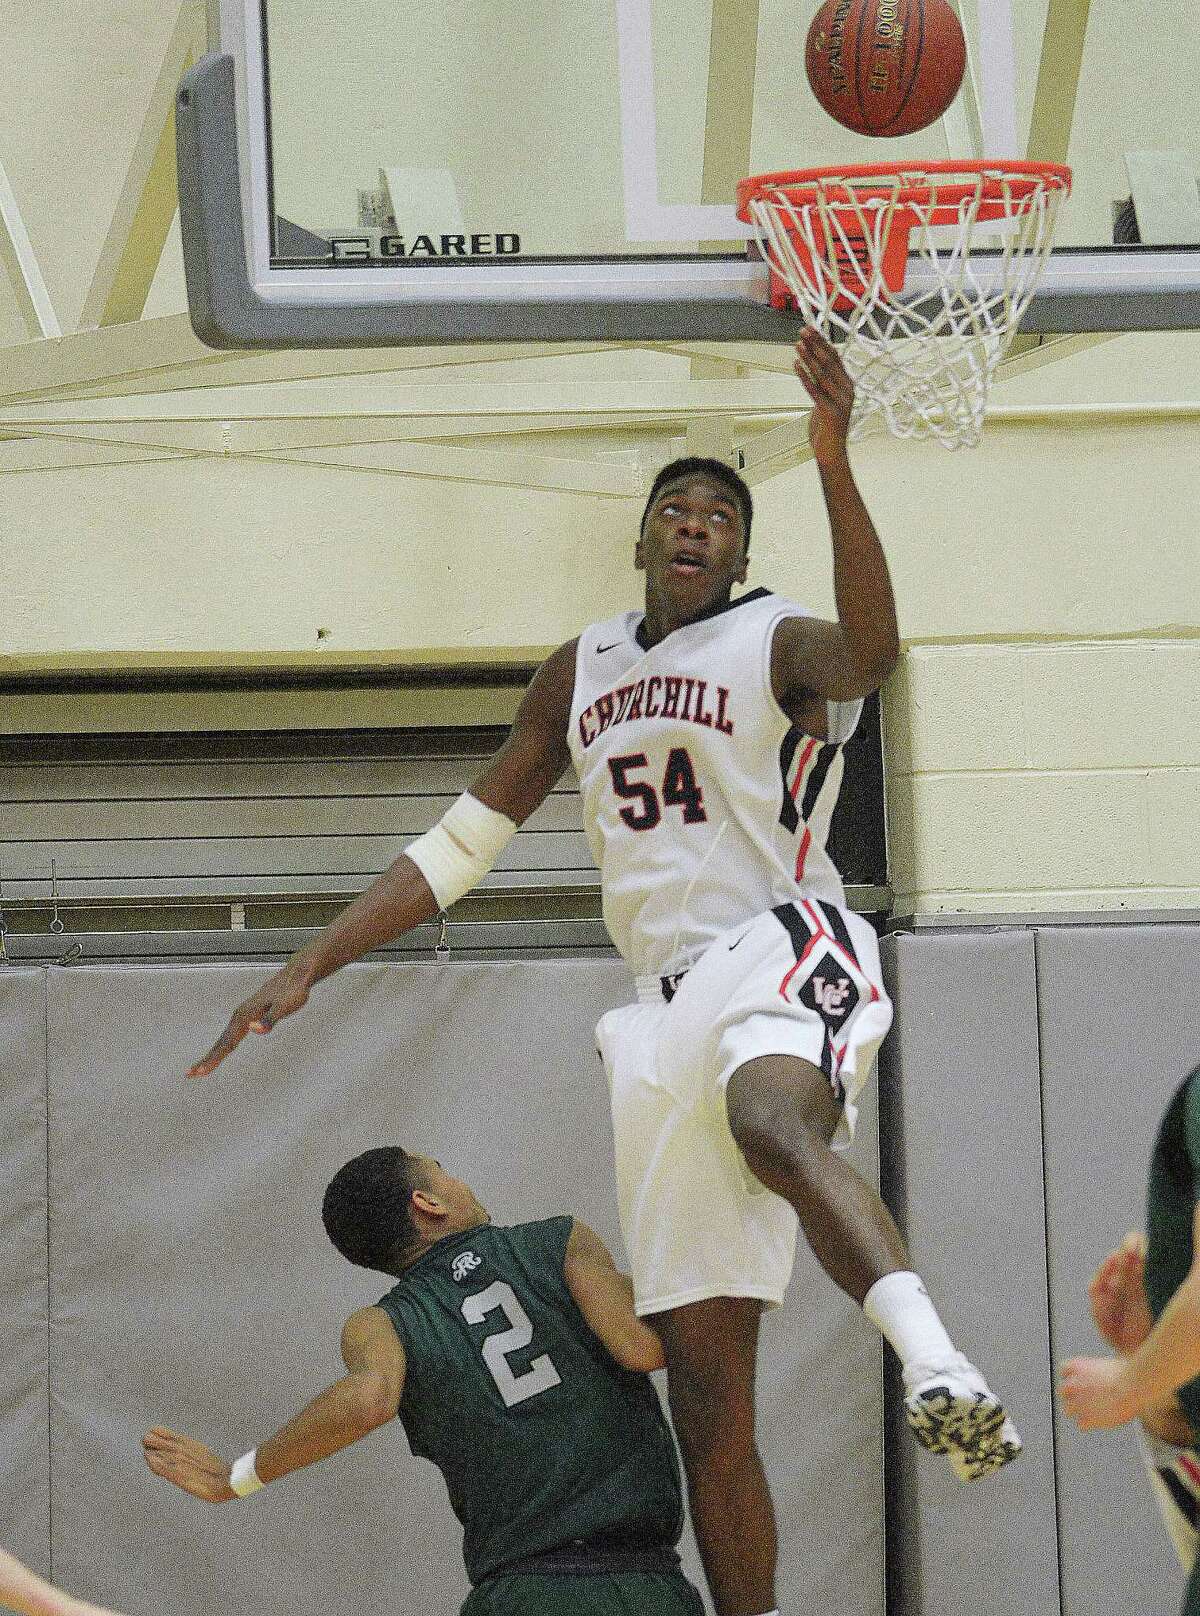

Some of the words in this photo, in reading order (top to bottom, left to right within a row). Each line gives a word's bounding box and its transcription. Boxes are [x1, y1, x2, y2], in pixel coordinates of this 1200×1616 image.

[379, 233, 521, 257] GARED
[579, 675, 734, 748] CHURCHILL
[607, 747, 707, 832] 54
[461, 1280, 562, 1408] 2
